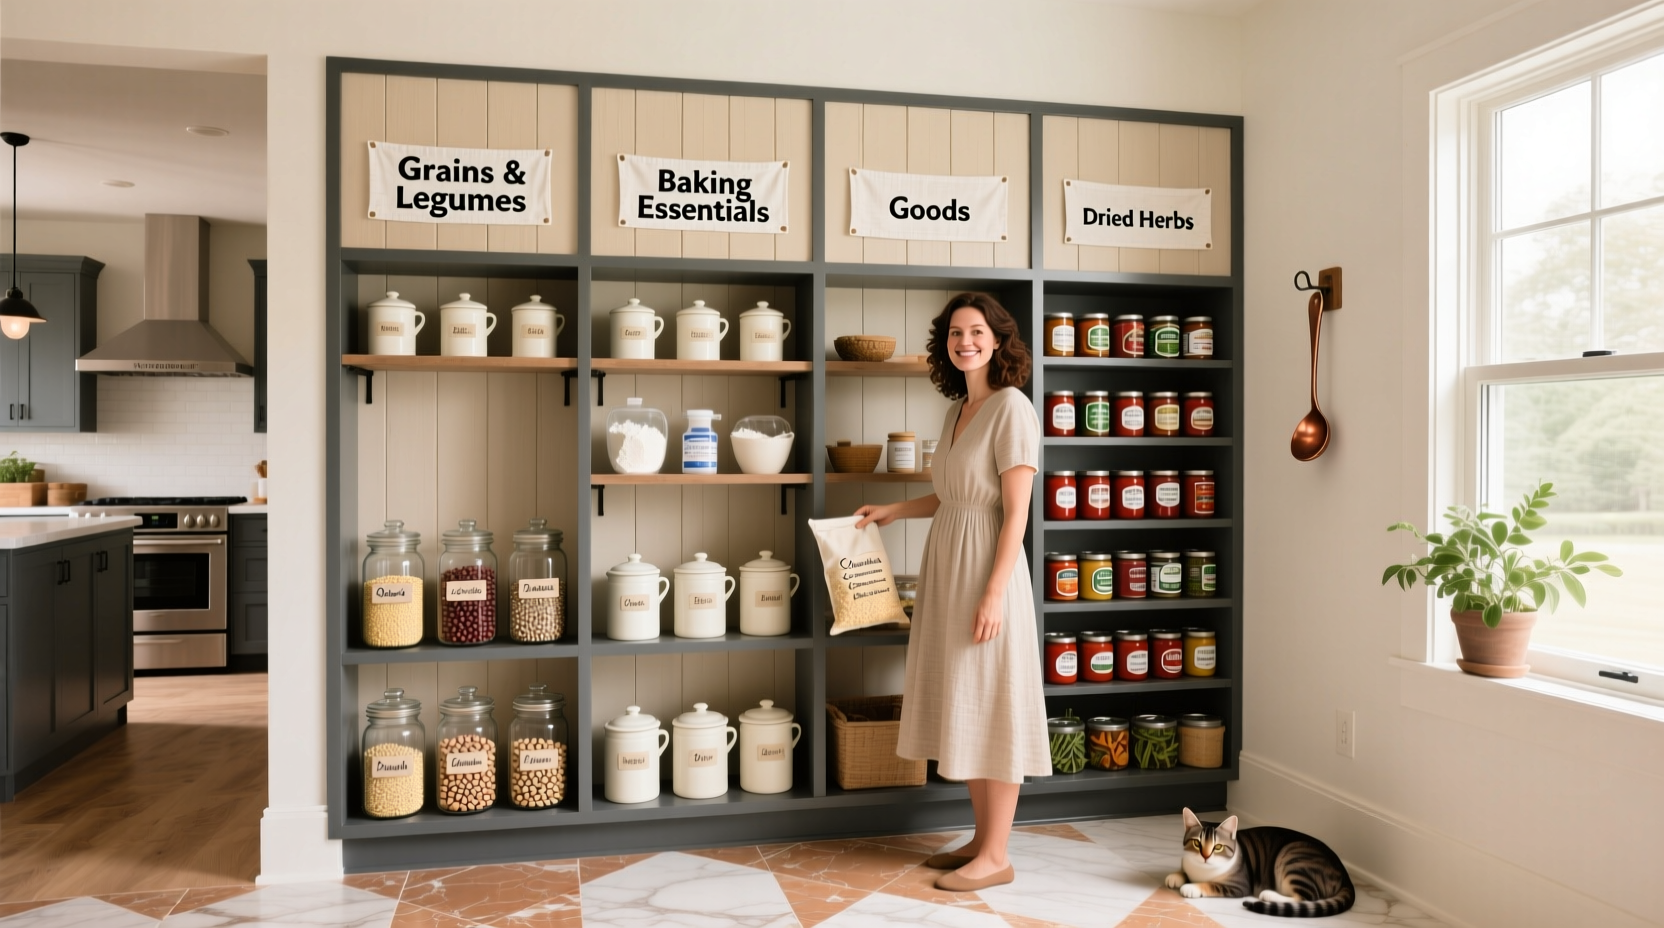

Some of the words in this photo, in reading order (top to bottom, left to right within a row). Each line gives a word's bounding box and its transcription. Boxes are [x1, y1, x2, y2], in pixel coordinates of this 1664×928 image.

[398, 155, 495, 184] Grains
[503, 159, 526, 185] &
[658, 168, 753, 202] Baking
[396, 185, 527, 218] Legumes
[637, 194, 770, 223] Essentials
[889, 195, 971, 221] Goods
[1083, 207, 1134, 228] Dried
[1139, 210, 1195, 231] Herbs
